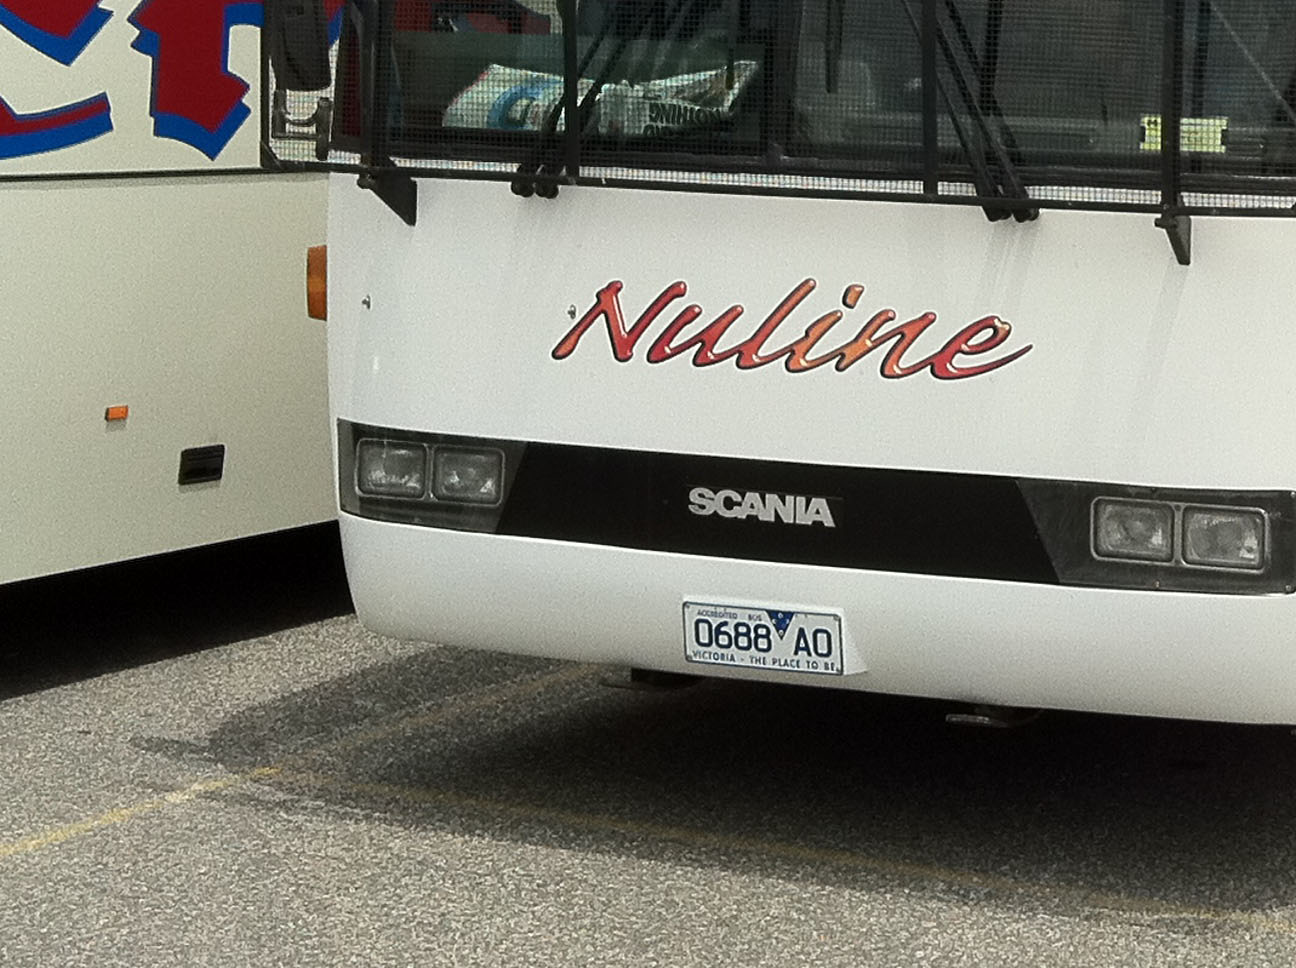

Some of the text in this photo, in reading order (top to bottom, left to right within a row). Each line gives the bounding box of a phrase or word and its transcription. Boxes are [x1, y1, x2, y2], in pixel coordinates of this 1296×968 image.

[551, 278, 1033, 380] Nuline
[688, 487, 836, 528] SCANIA
[694, 618, 772, 653] 0688
[691, 649, 736, 663] VICTORIA
[749, 656, 767, 666] THE
[772, 659, 801, 669] PLACE
[806, 661, 819, 670] TO
